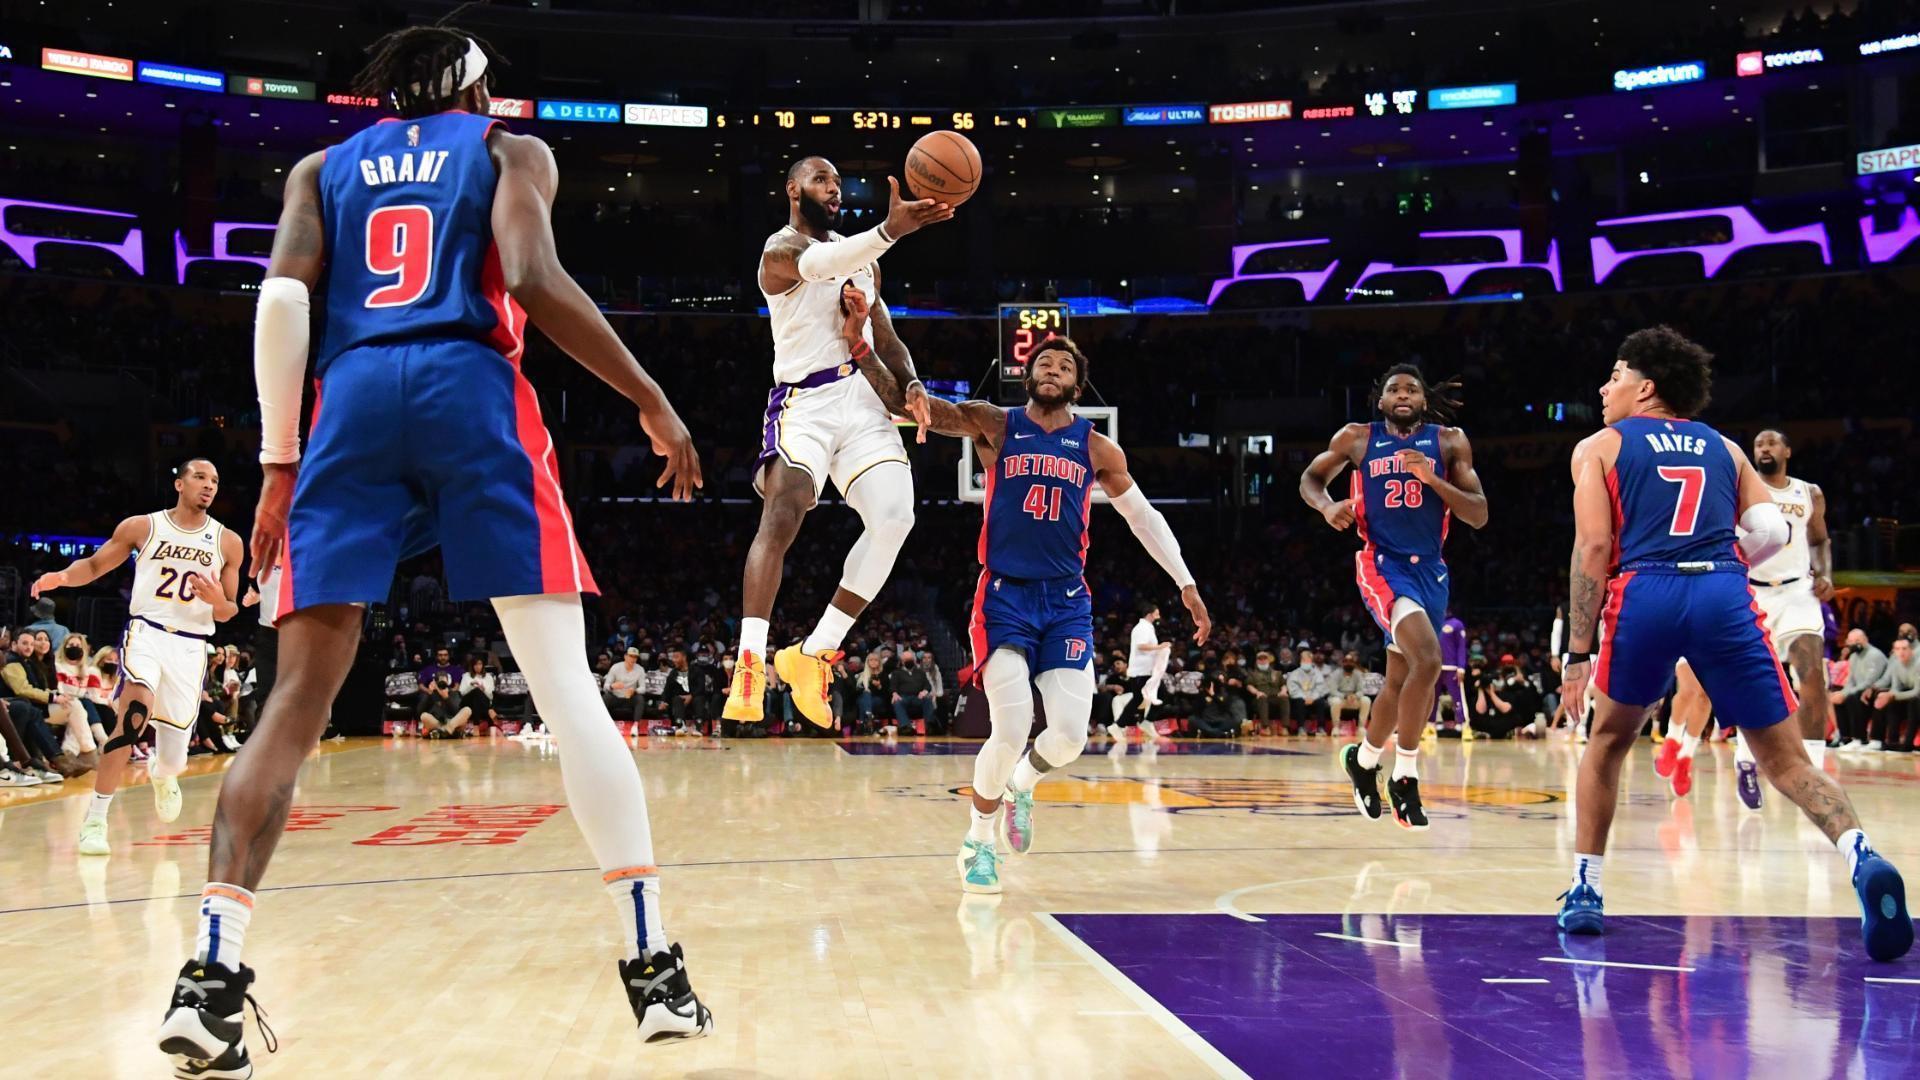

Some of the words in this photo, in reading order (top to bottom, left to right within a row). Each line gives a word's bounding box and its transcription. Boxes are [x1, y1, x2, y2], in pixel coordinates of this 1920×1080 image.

[48, 52, 87, 67] WELLS
[89, 57, 128, 74] FARGO
[1764, 49, 1823, 68] TOYOTA
[1614, 63, 1699, 90] Spectrum
[264, 83, 299, 94] TOYOTA
[560, 105, 619, 119] DELTA
[627, 106, 705, 126] STAPLES
[775, 111, 795, 128] 70
[853, 111, 888, 129] 5:27
[952, 112, 974, 129] 56
[1167, 110, 1202, 120] ULTRA
[1210, 103, 1291, 121] TOSHIBA
[1303, 106, 1354, 119] ASSISTS
[359, 151, 450, 186] GRANT
[364, 204, 434, 309] 9
[1019, 309, 1060, 329] 5:27
[1645, 433, 1707, 455] HAYES
[1003, 453, 1087, 489] DETROIT
[1369, 455, 1436, 478] DETT
[1023, 484, 1063, 521] 41
[1384, 479, 1423, 509] 28
[1657, 465, 1706, 536] 7
[151, 540, 214, 567] LAKERS
[155, 566, 199, 604] 20
